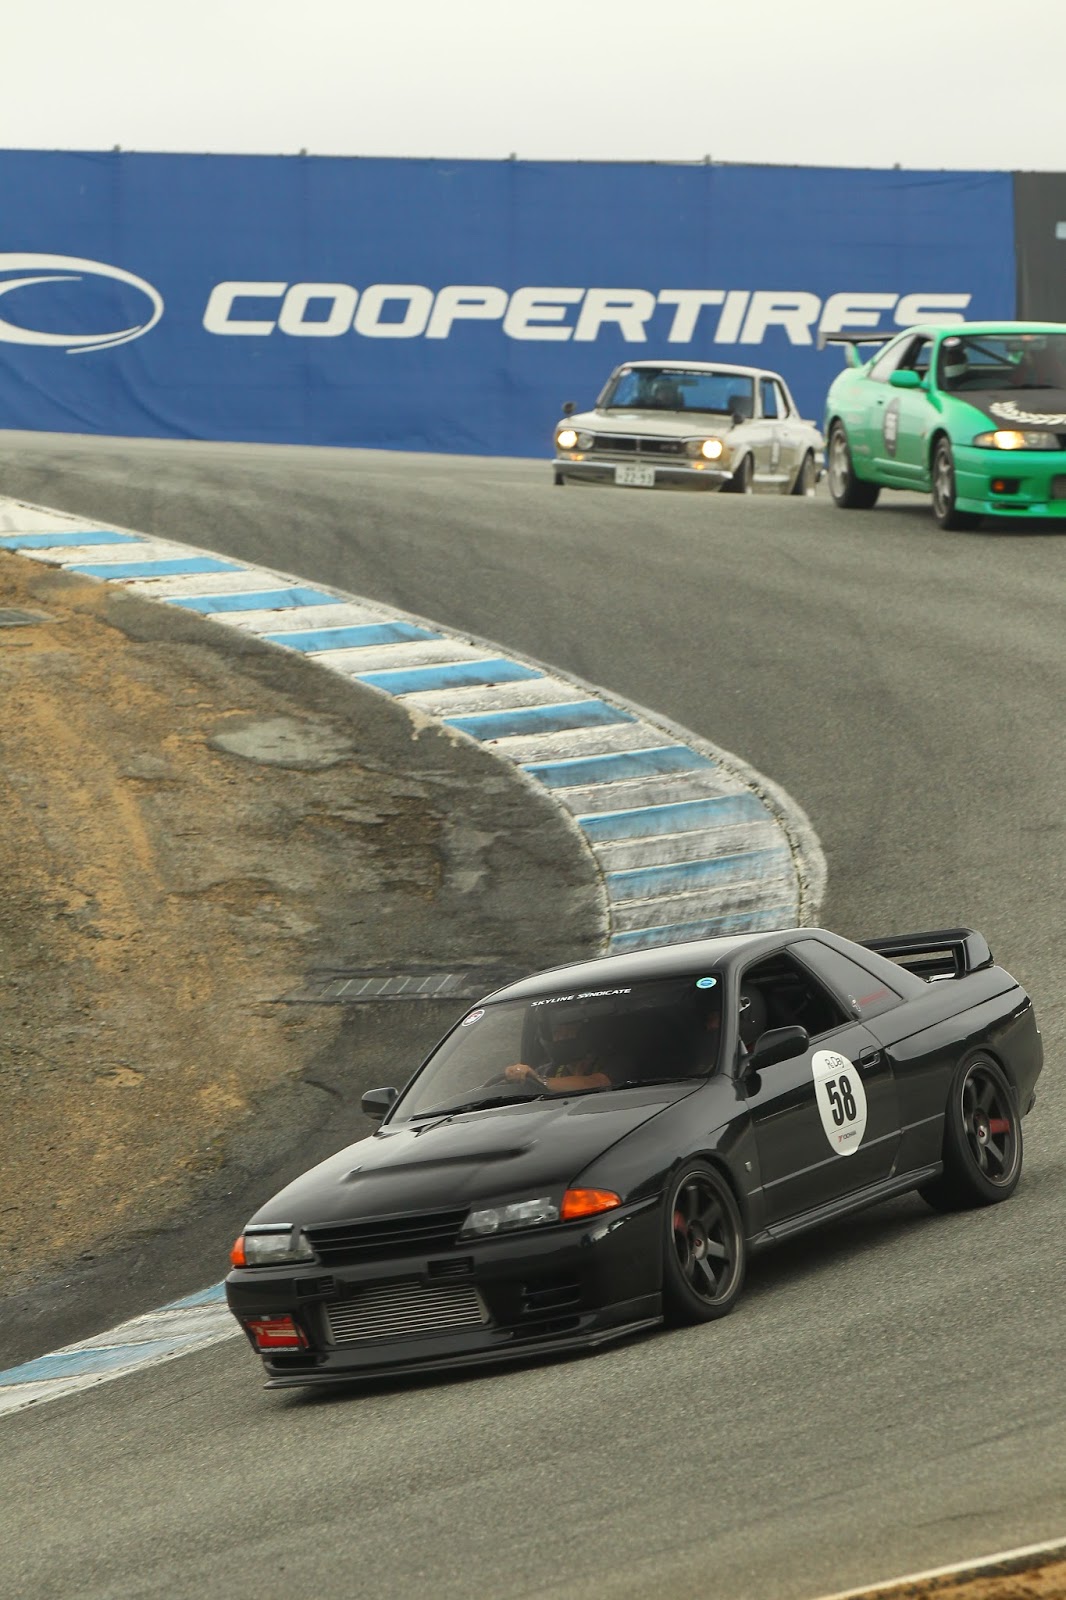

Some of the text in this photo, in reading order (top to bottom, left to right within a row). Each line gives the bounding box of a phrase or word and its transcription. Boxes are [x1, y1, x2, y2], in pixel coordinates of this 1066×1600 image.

[531, 988, 632, 1006] SKYLINE SYNDICATE
[825, 1075, 857, 1126] 58
